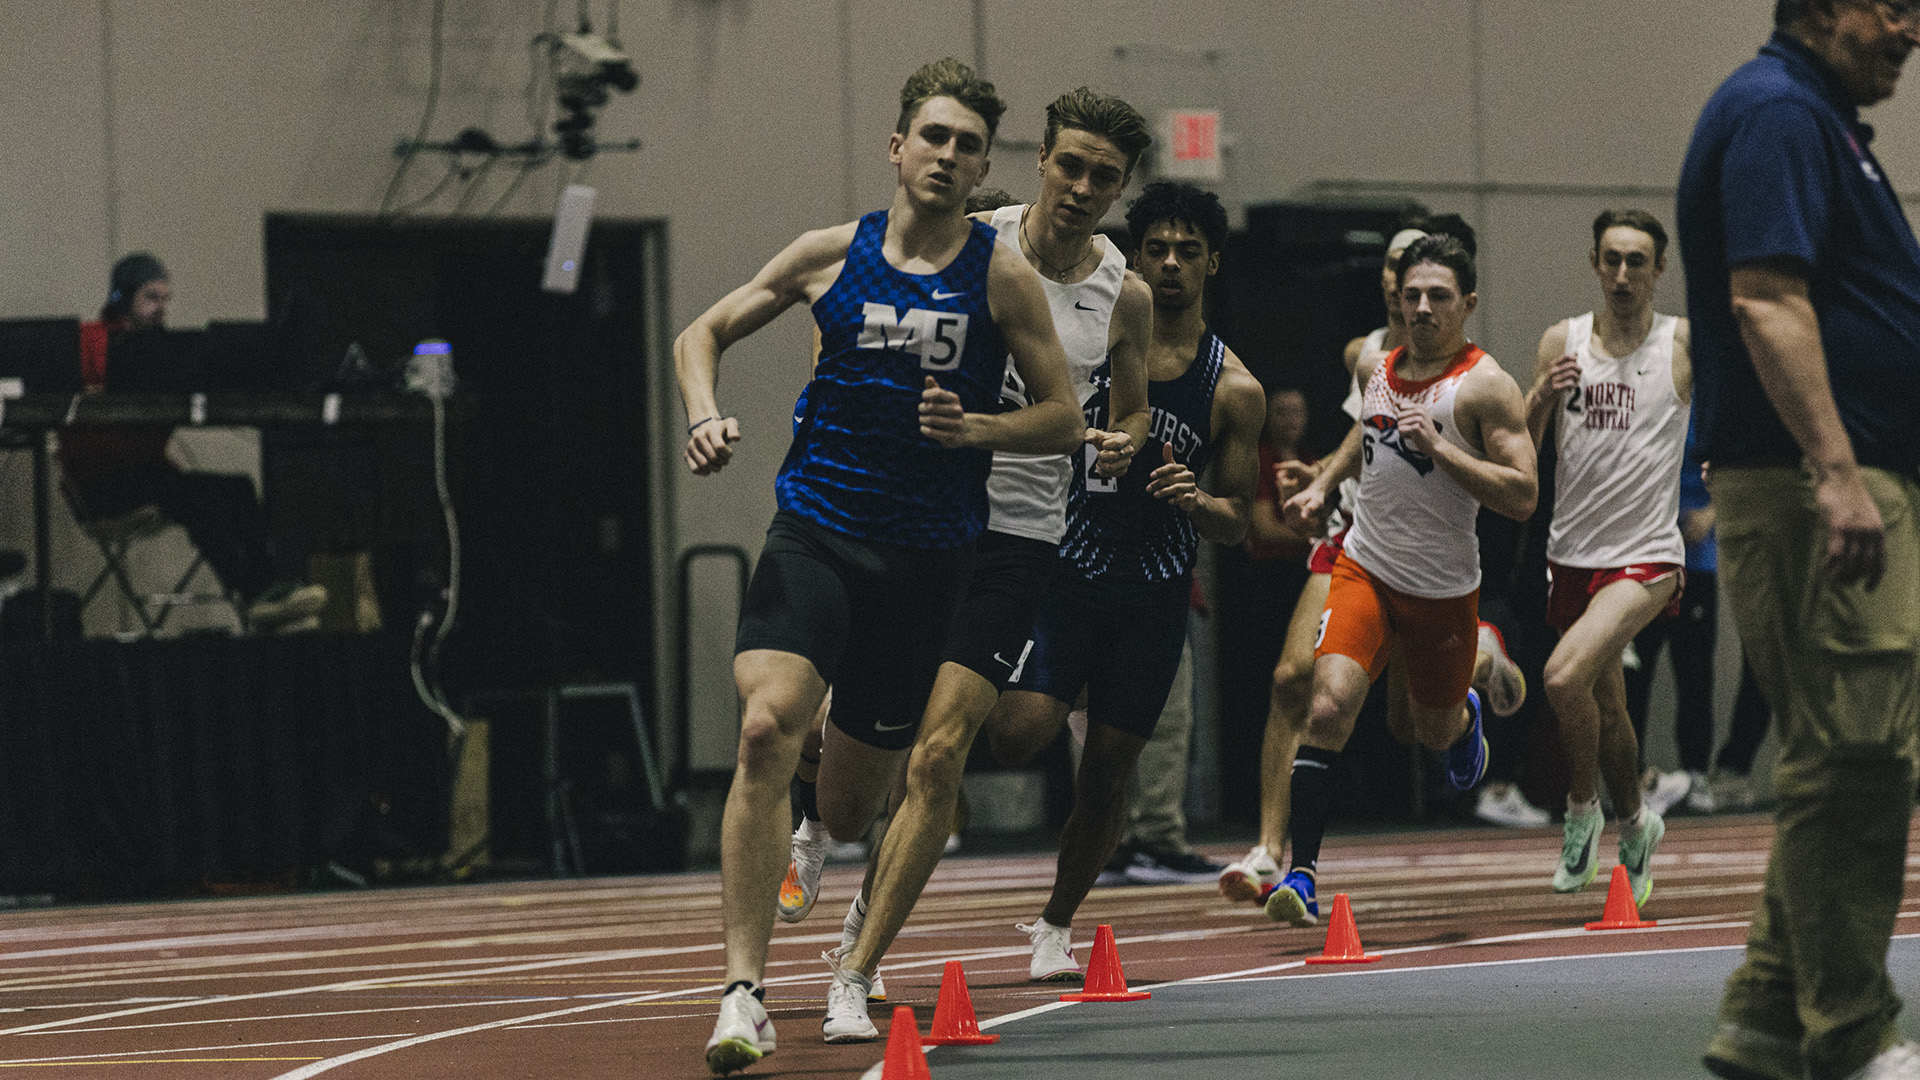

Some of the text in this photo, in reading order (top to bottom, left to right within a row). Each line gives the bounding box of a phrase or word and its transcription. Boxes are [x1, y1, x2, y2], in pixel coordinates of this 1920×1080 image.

[929, 318, 959, 365] 5
[1567, 386, 1581, 412] 2
[1585, 381, 1636, 412] NORTH
[1363, 433, 1376, 465] 6
